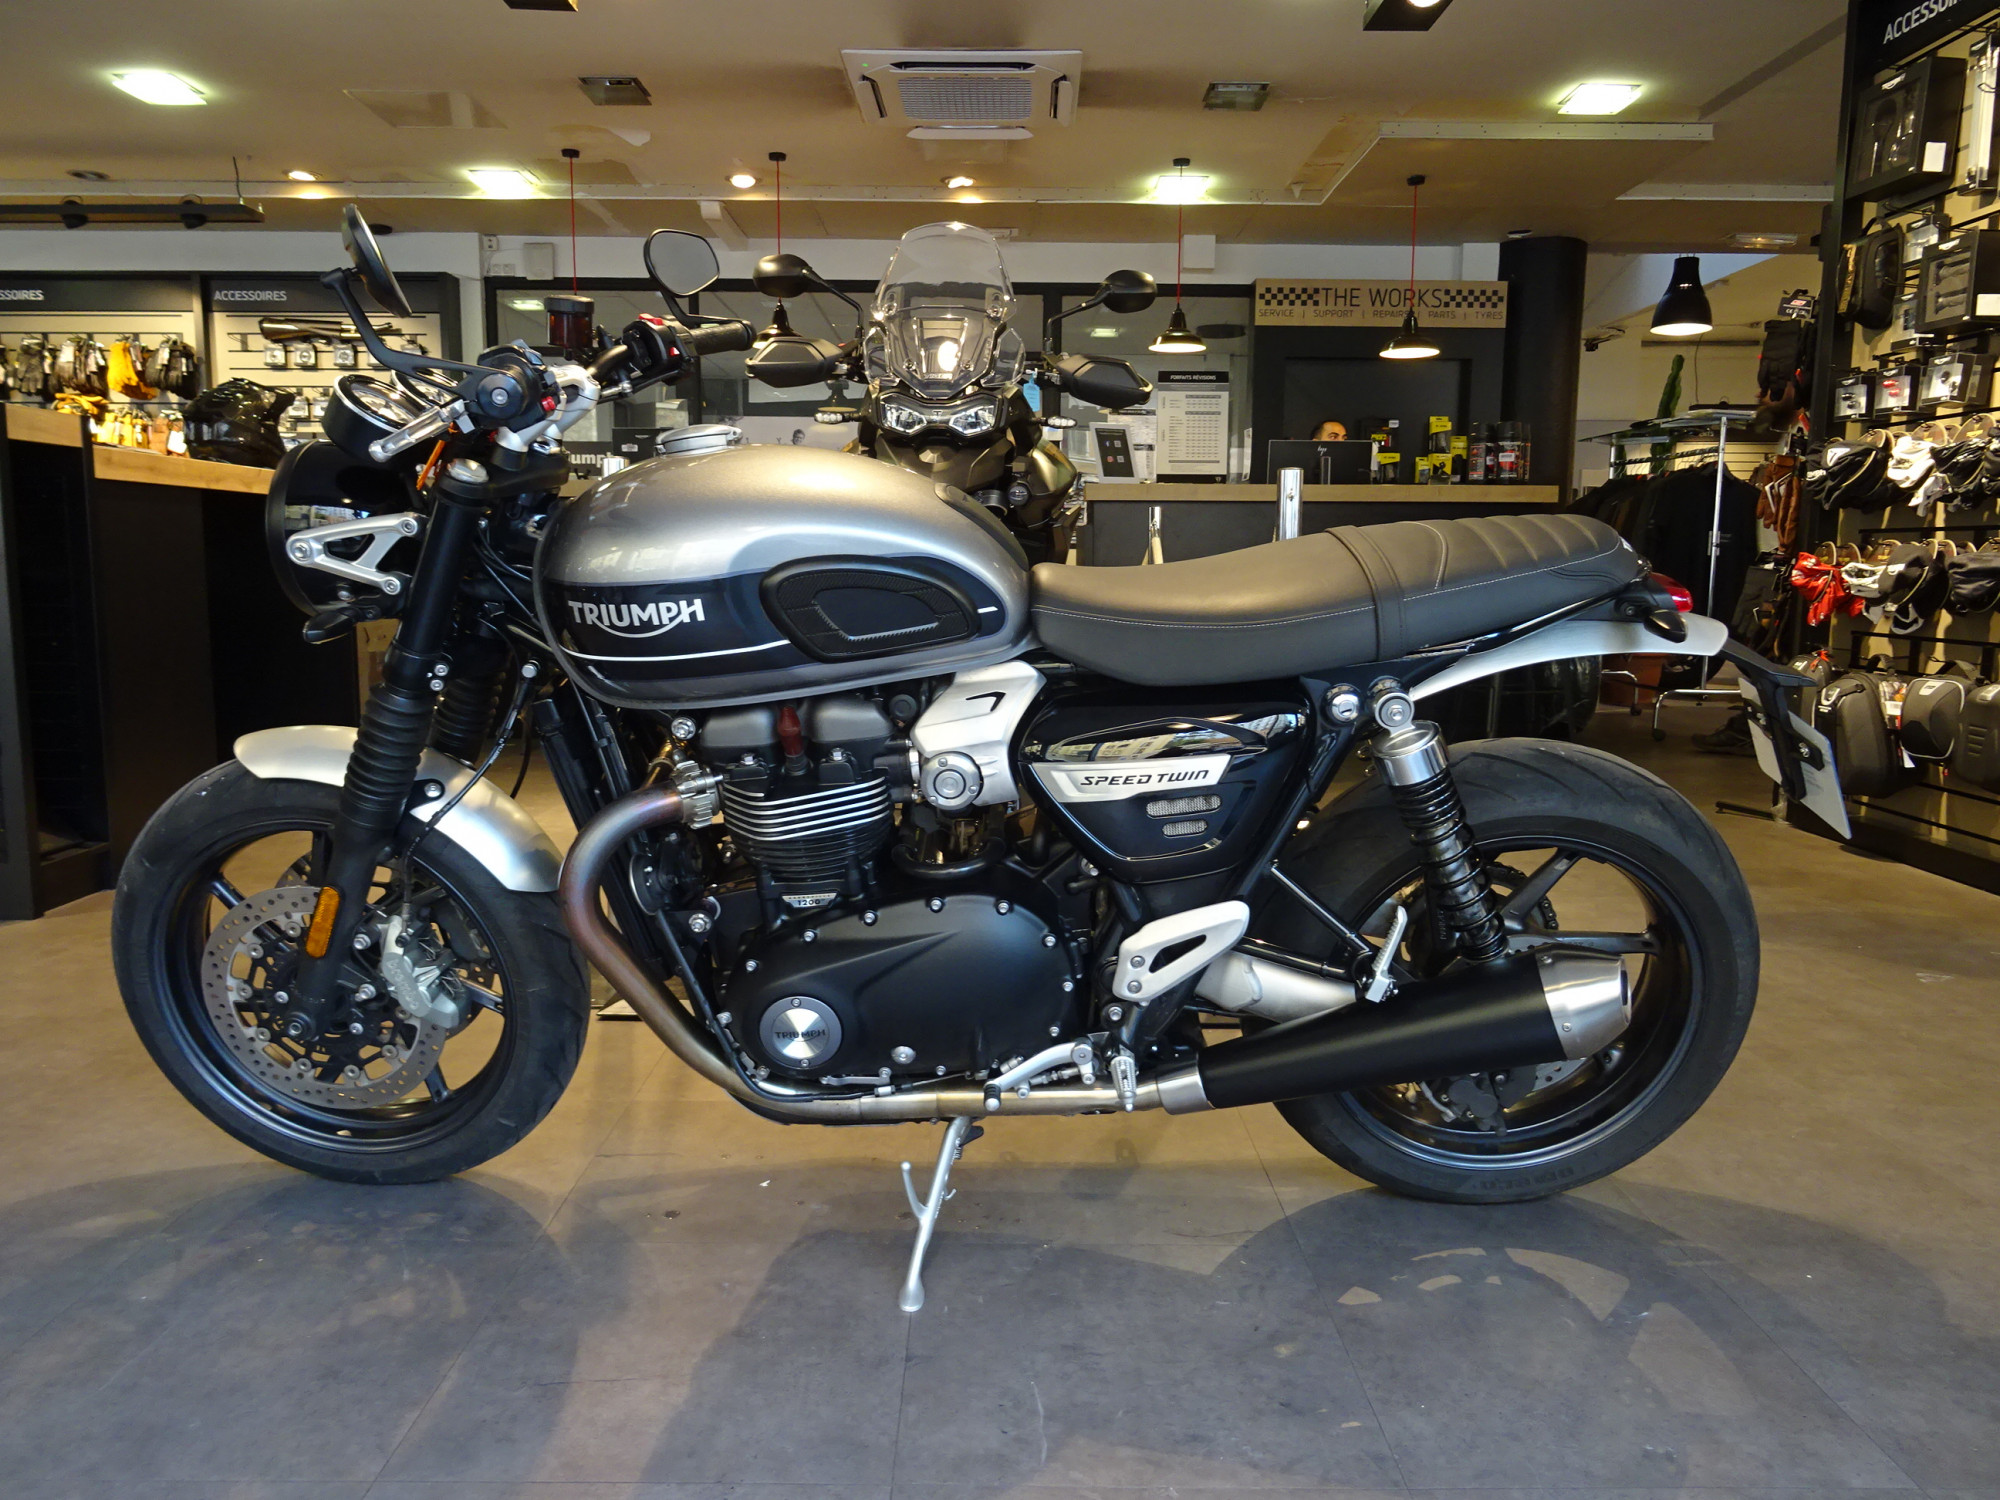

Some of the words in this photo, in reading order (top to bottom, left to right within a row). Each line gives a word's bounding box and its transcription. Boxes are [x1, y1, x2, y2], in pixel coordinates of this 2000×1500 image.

[214, 291, 287, 301] ACCESSOIRES
[1321, 287, 1361, 307] THE
[1368, 288, 1442, 308] WORKS
[1258, 309, 1295, 318] SERVICE
[1313, 309, 1354, 318] SUPPORT
[1428, 310, 1456, 320] PARTS
[1475, 311, 1504, 320] TYRES
[568, 598, 706, 638] TRIUMPH
[1080, 774, 1153, 786] SPEED
[1157, 769, 1210, 784] TWIN
[774, 1029, 826, 1042] TRIUMPH
